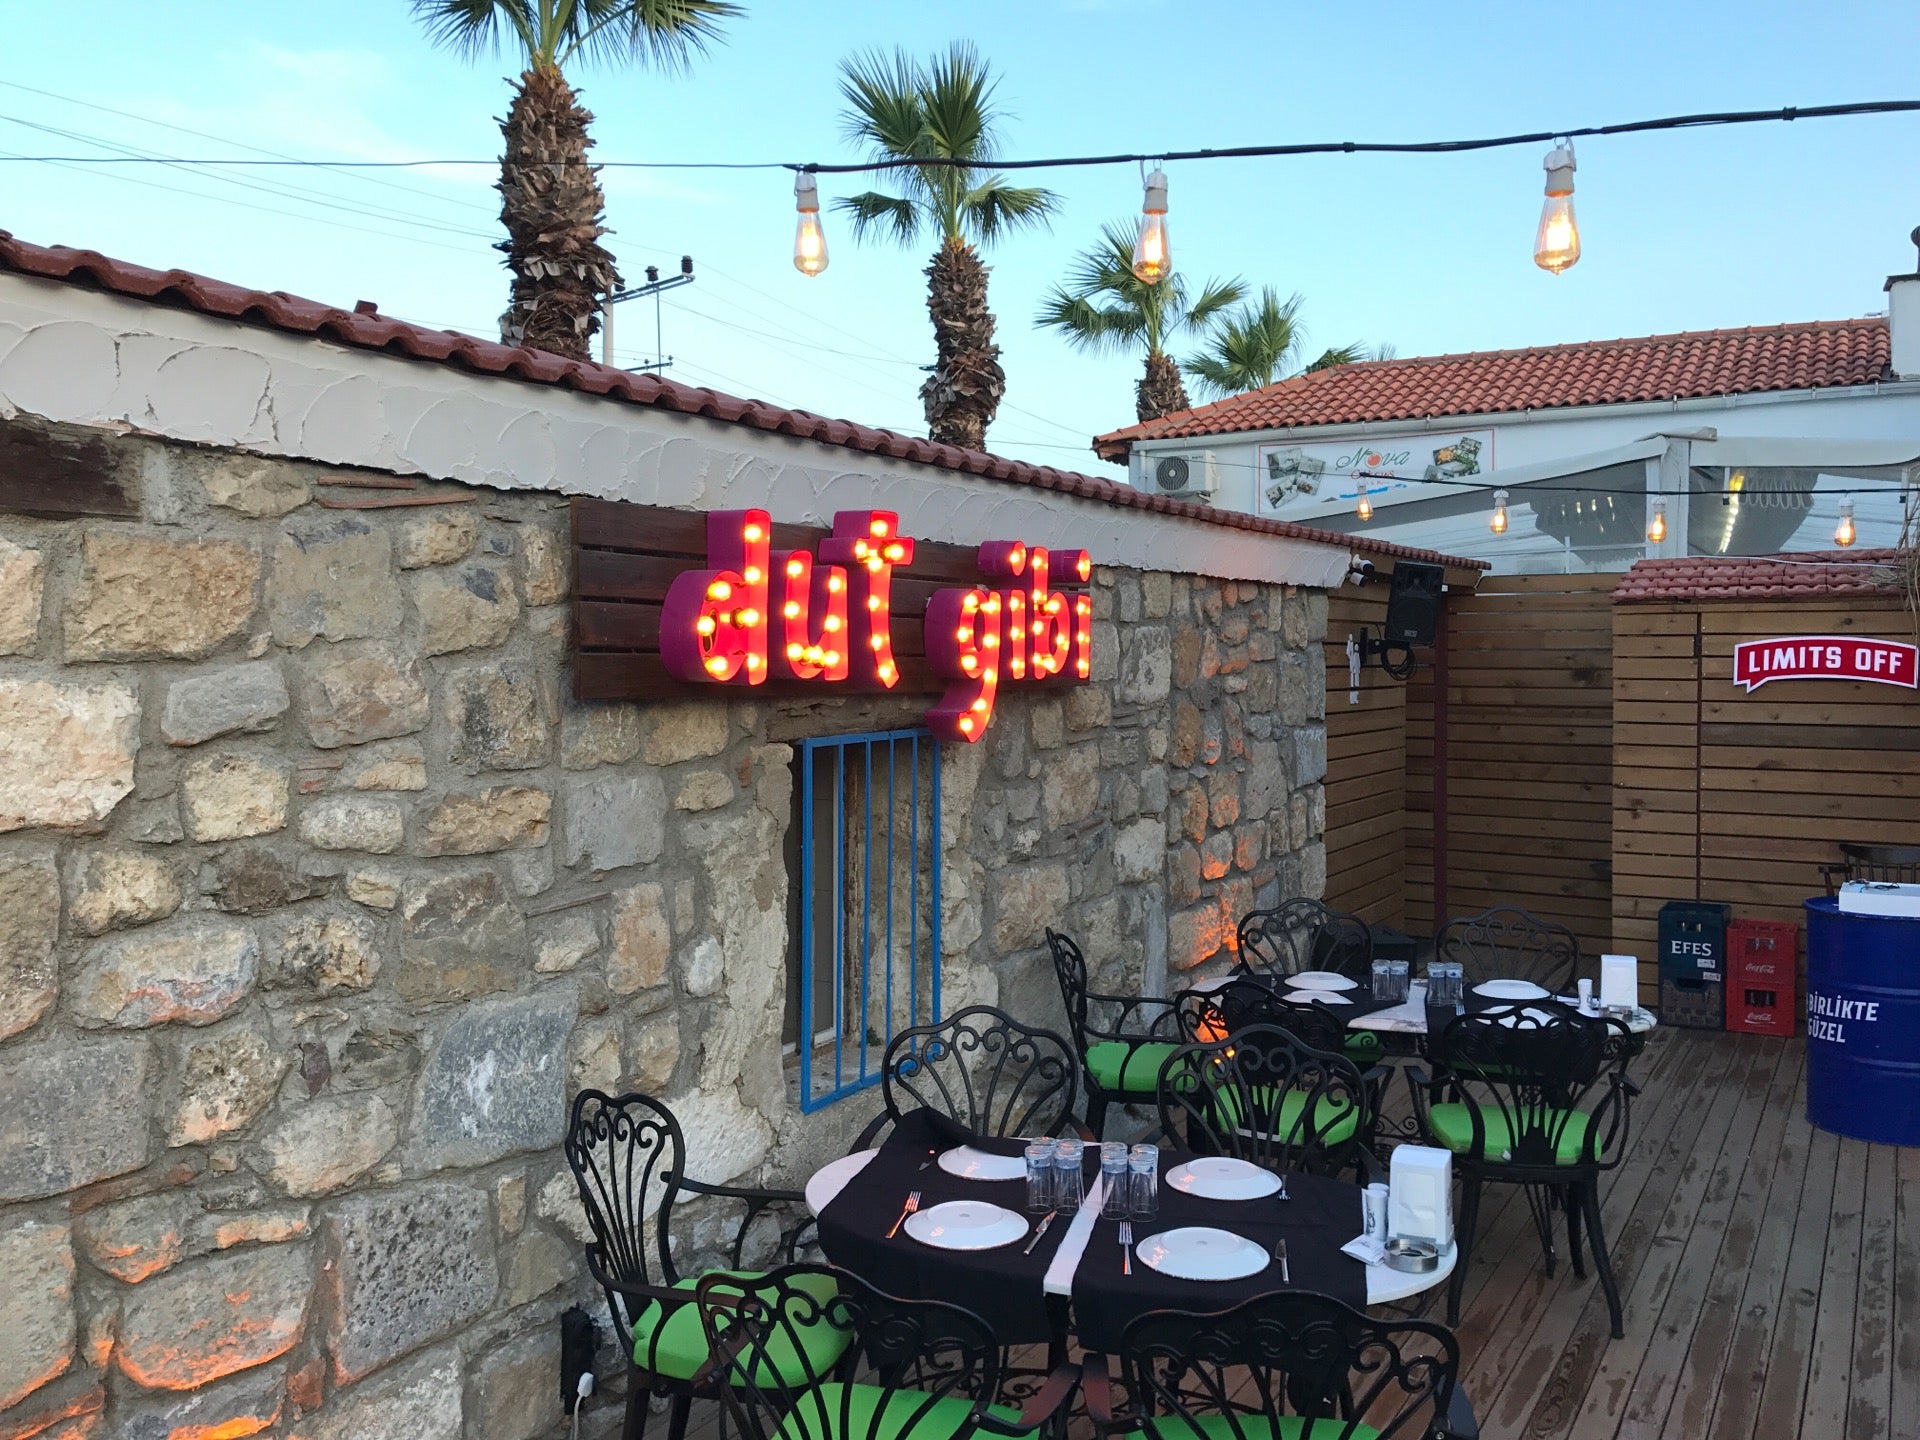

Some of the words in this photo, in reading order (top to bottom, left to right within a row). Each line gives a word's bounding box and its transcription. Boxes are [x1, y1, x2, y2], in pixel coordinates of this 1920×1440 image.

[1335, 447, 1410, 470] Nova
[659, 508, 914, 689] dut
[924, 540, 1091, 744] gibi
[1749, 646, 1842, 673] LIMITS
[1855, 648, 1903, 674] OFF
[1671, 940, 1712, 957] EFES
